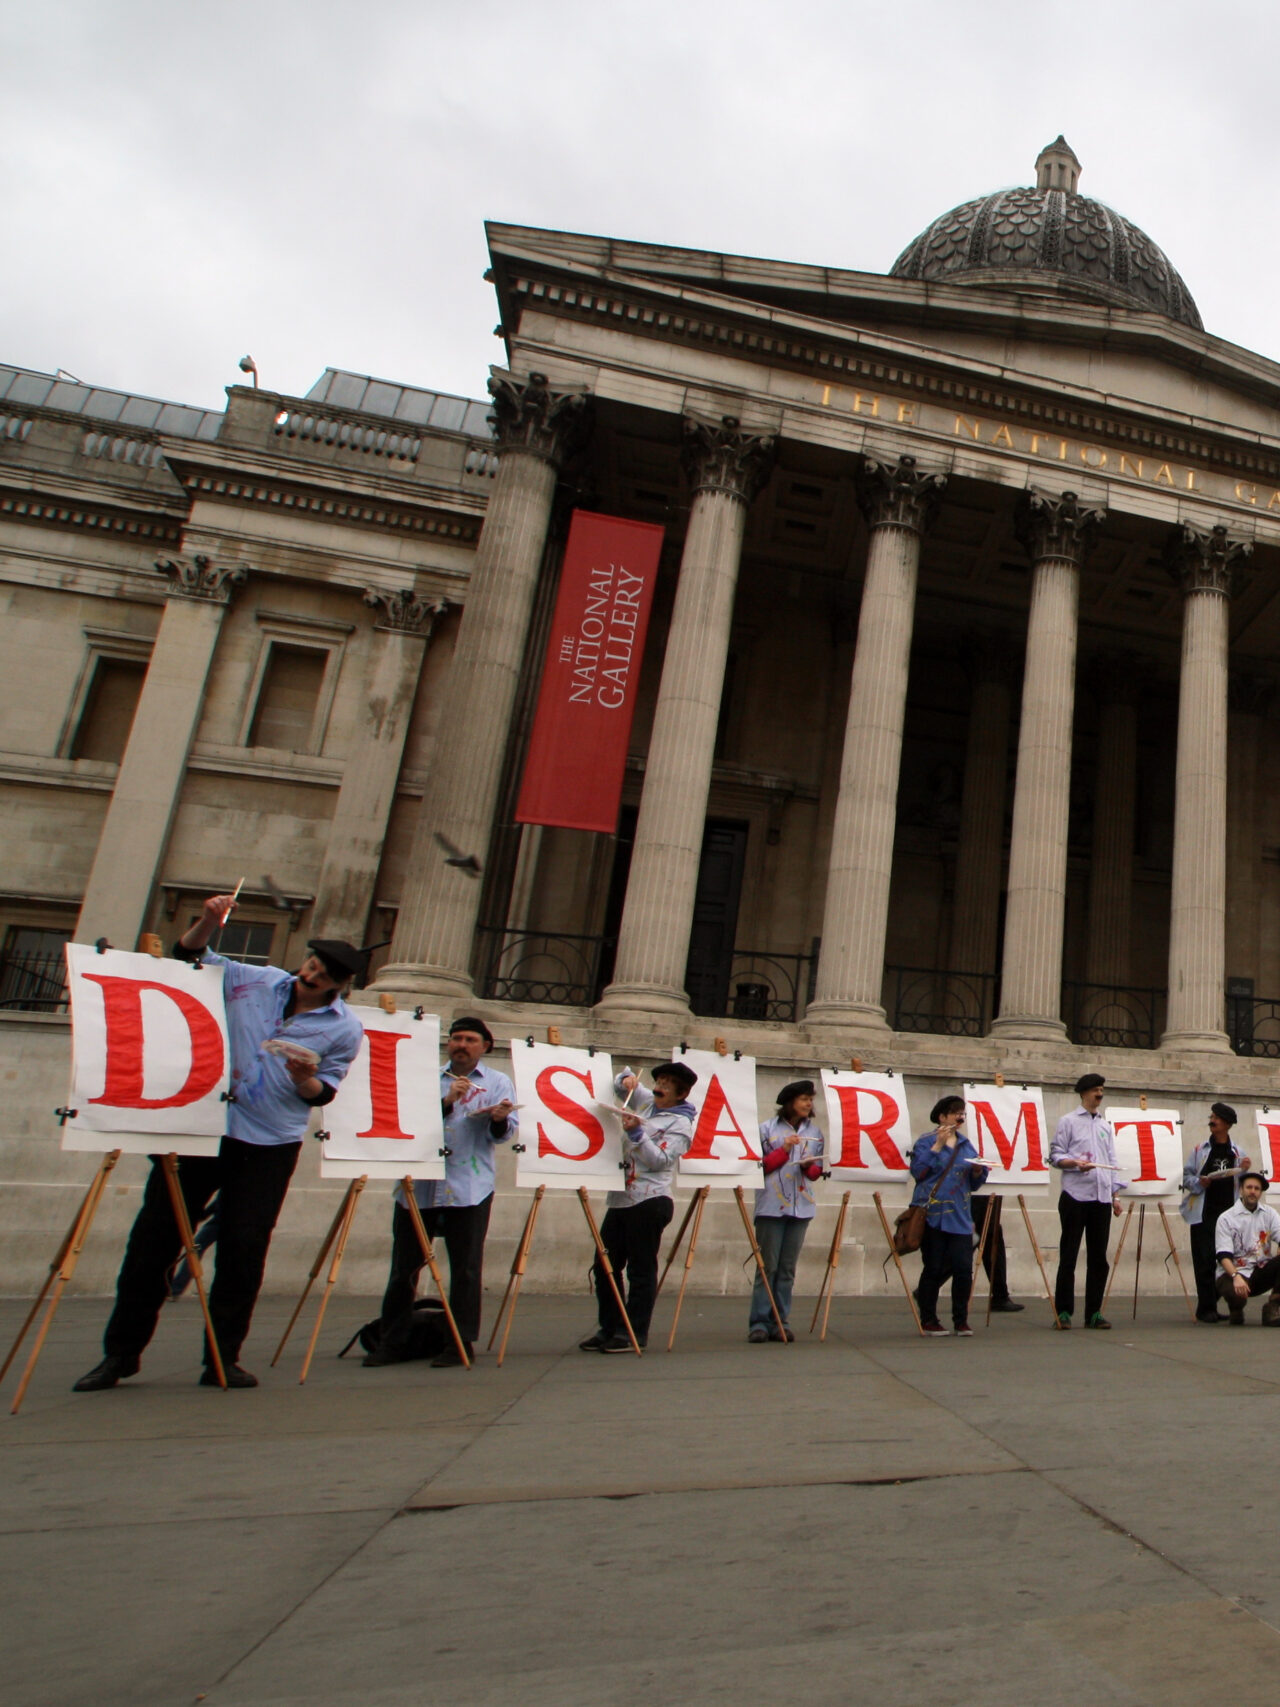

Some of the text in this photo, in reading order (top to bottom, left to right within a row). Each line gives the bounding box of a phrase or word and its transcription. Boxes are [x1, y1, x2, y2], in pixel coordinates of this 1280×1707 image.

[814, 381, 915, 426] THE
[953, 413, 1201, 491] NATIONAL
[558, 635, 575, 663] THE
[568, 562, 615, 704] NATIONAL
[597, 565, 645, 709] GALLERY
